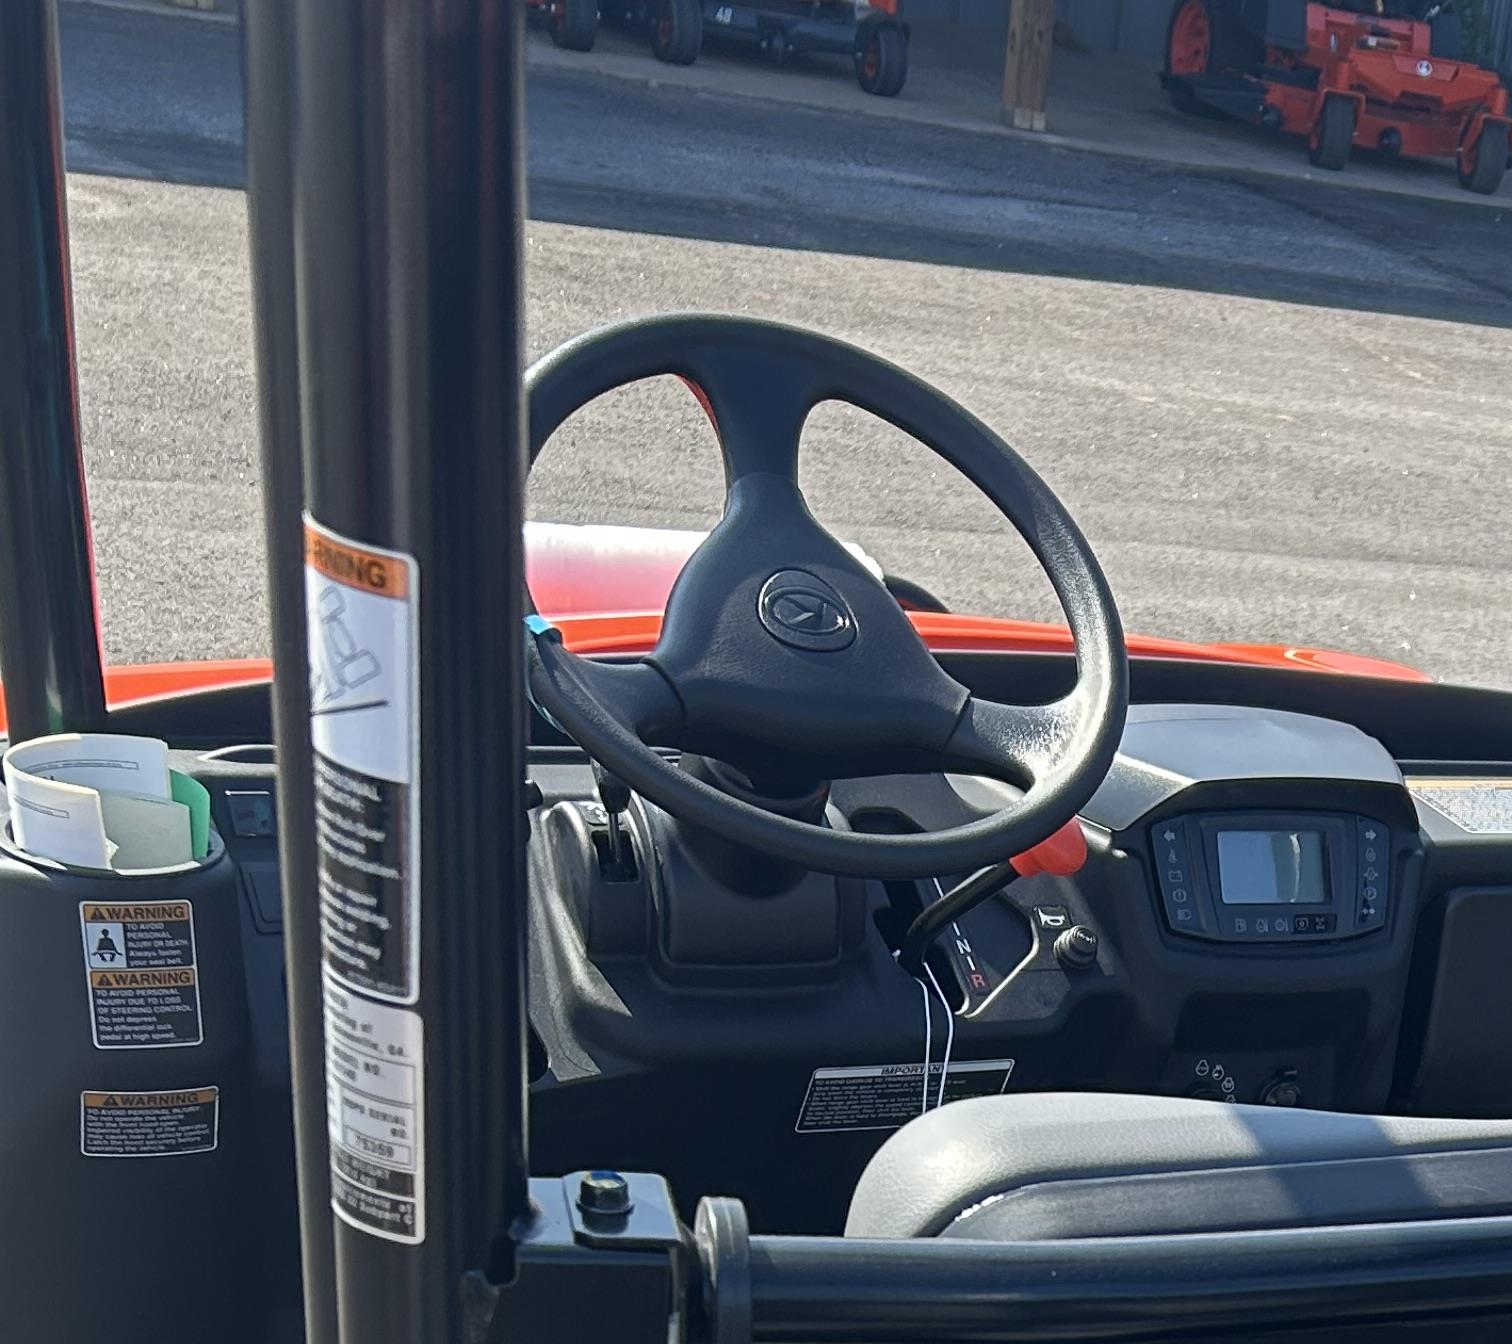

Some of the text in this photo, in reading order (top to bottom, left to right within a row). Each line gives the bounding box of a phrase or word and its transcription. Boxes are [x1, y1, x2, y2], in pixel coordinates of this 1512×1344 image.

[106, 906, 185, 920] WARNING
[956, 938, 972, 954] N
[113, 972, 191, 986] WARNING
[971, 974, 986, 988] R
[881, 1065, 949, 1076] IMPORTAN
[120, 1093, 198, 1107] WARNING
